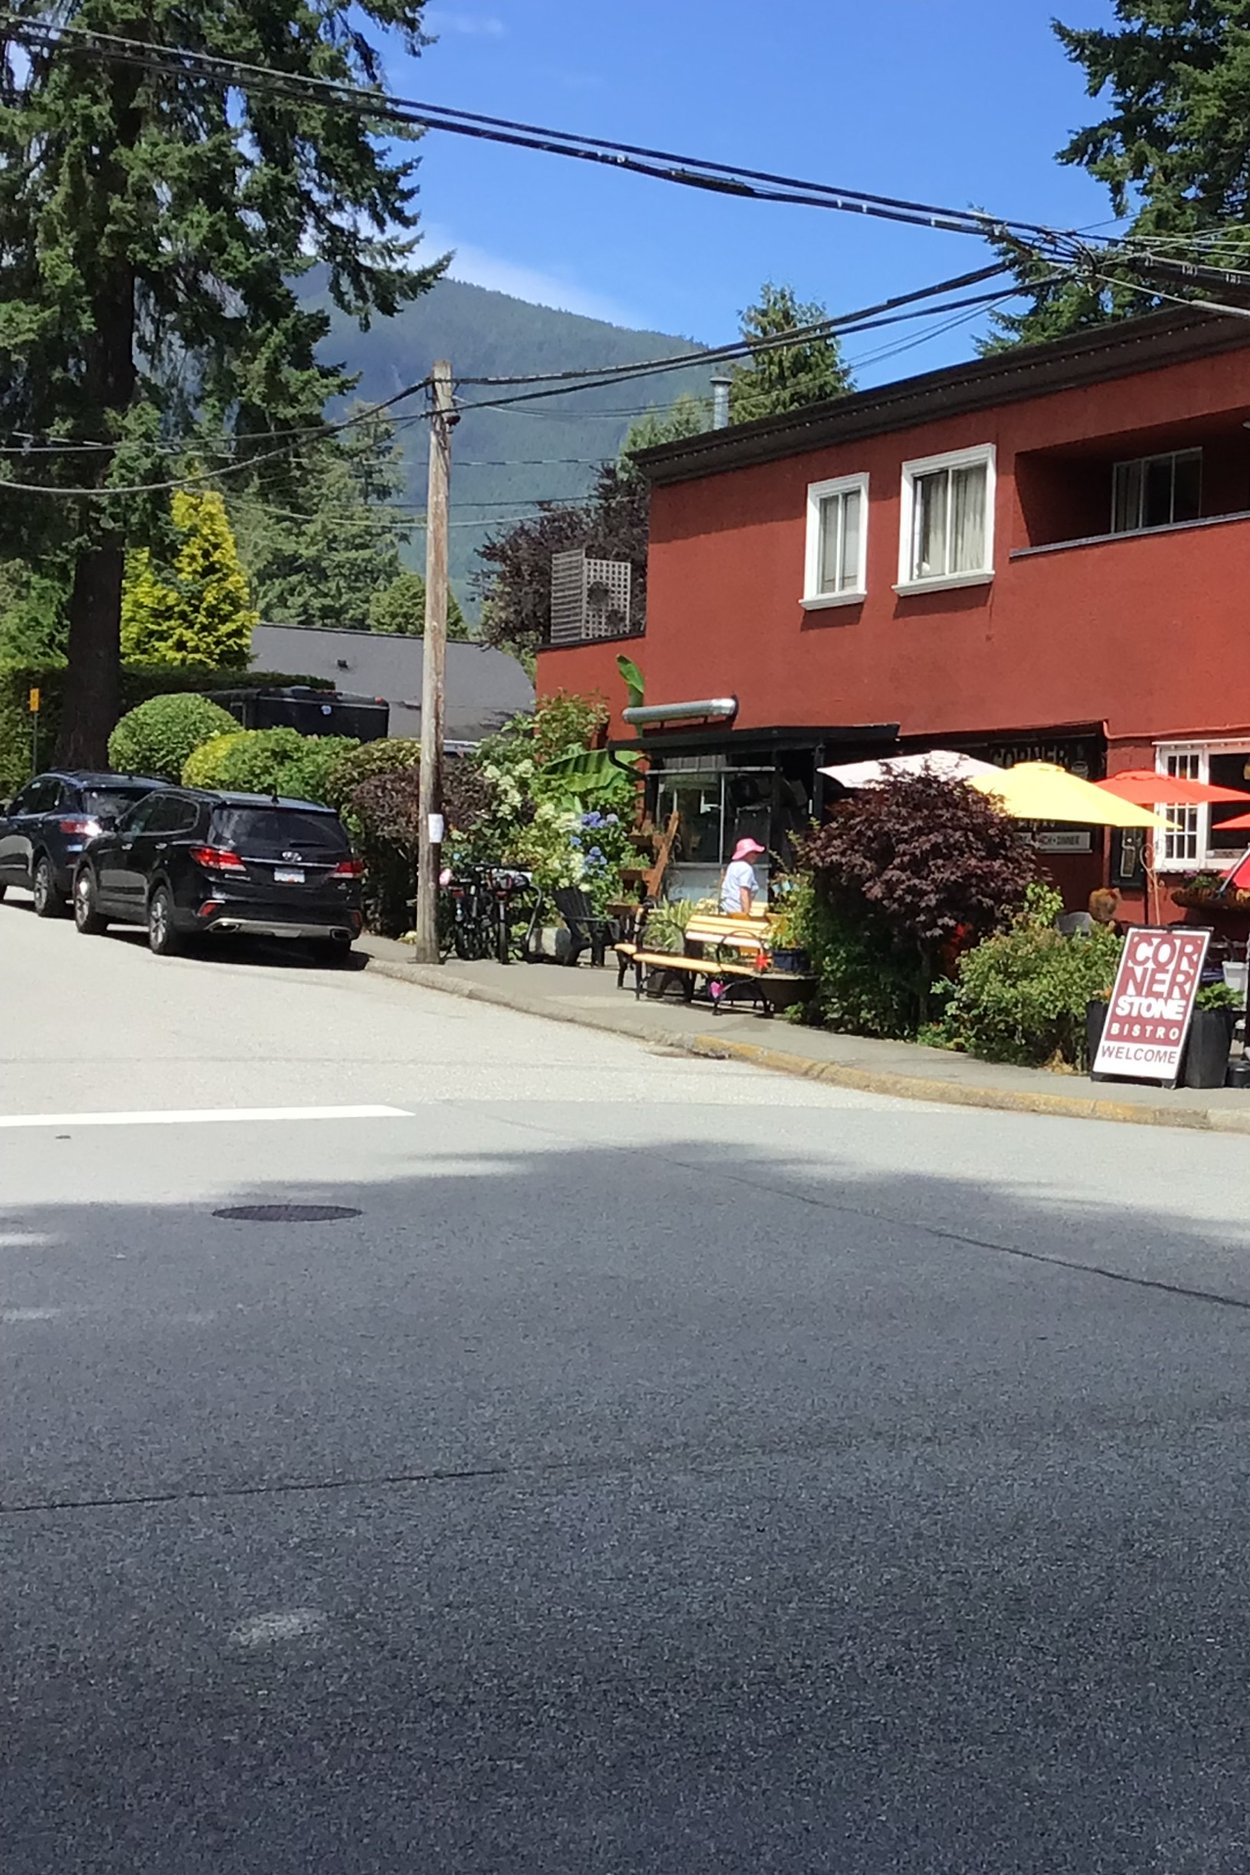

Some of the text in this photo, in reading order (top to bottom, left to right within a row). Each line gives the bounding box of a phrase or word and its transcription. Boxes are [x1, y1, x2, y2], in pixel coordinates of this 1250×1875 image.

[1128, 935, 1201, 971] COR
[1118, 967, 1195, 1000] NER
[1115, 995, 1187, 1021] STONE
[1110, 1023, 1180, 1040] BISTRO
[1101, 1045, 1177, 1064] WELCOME
